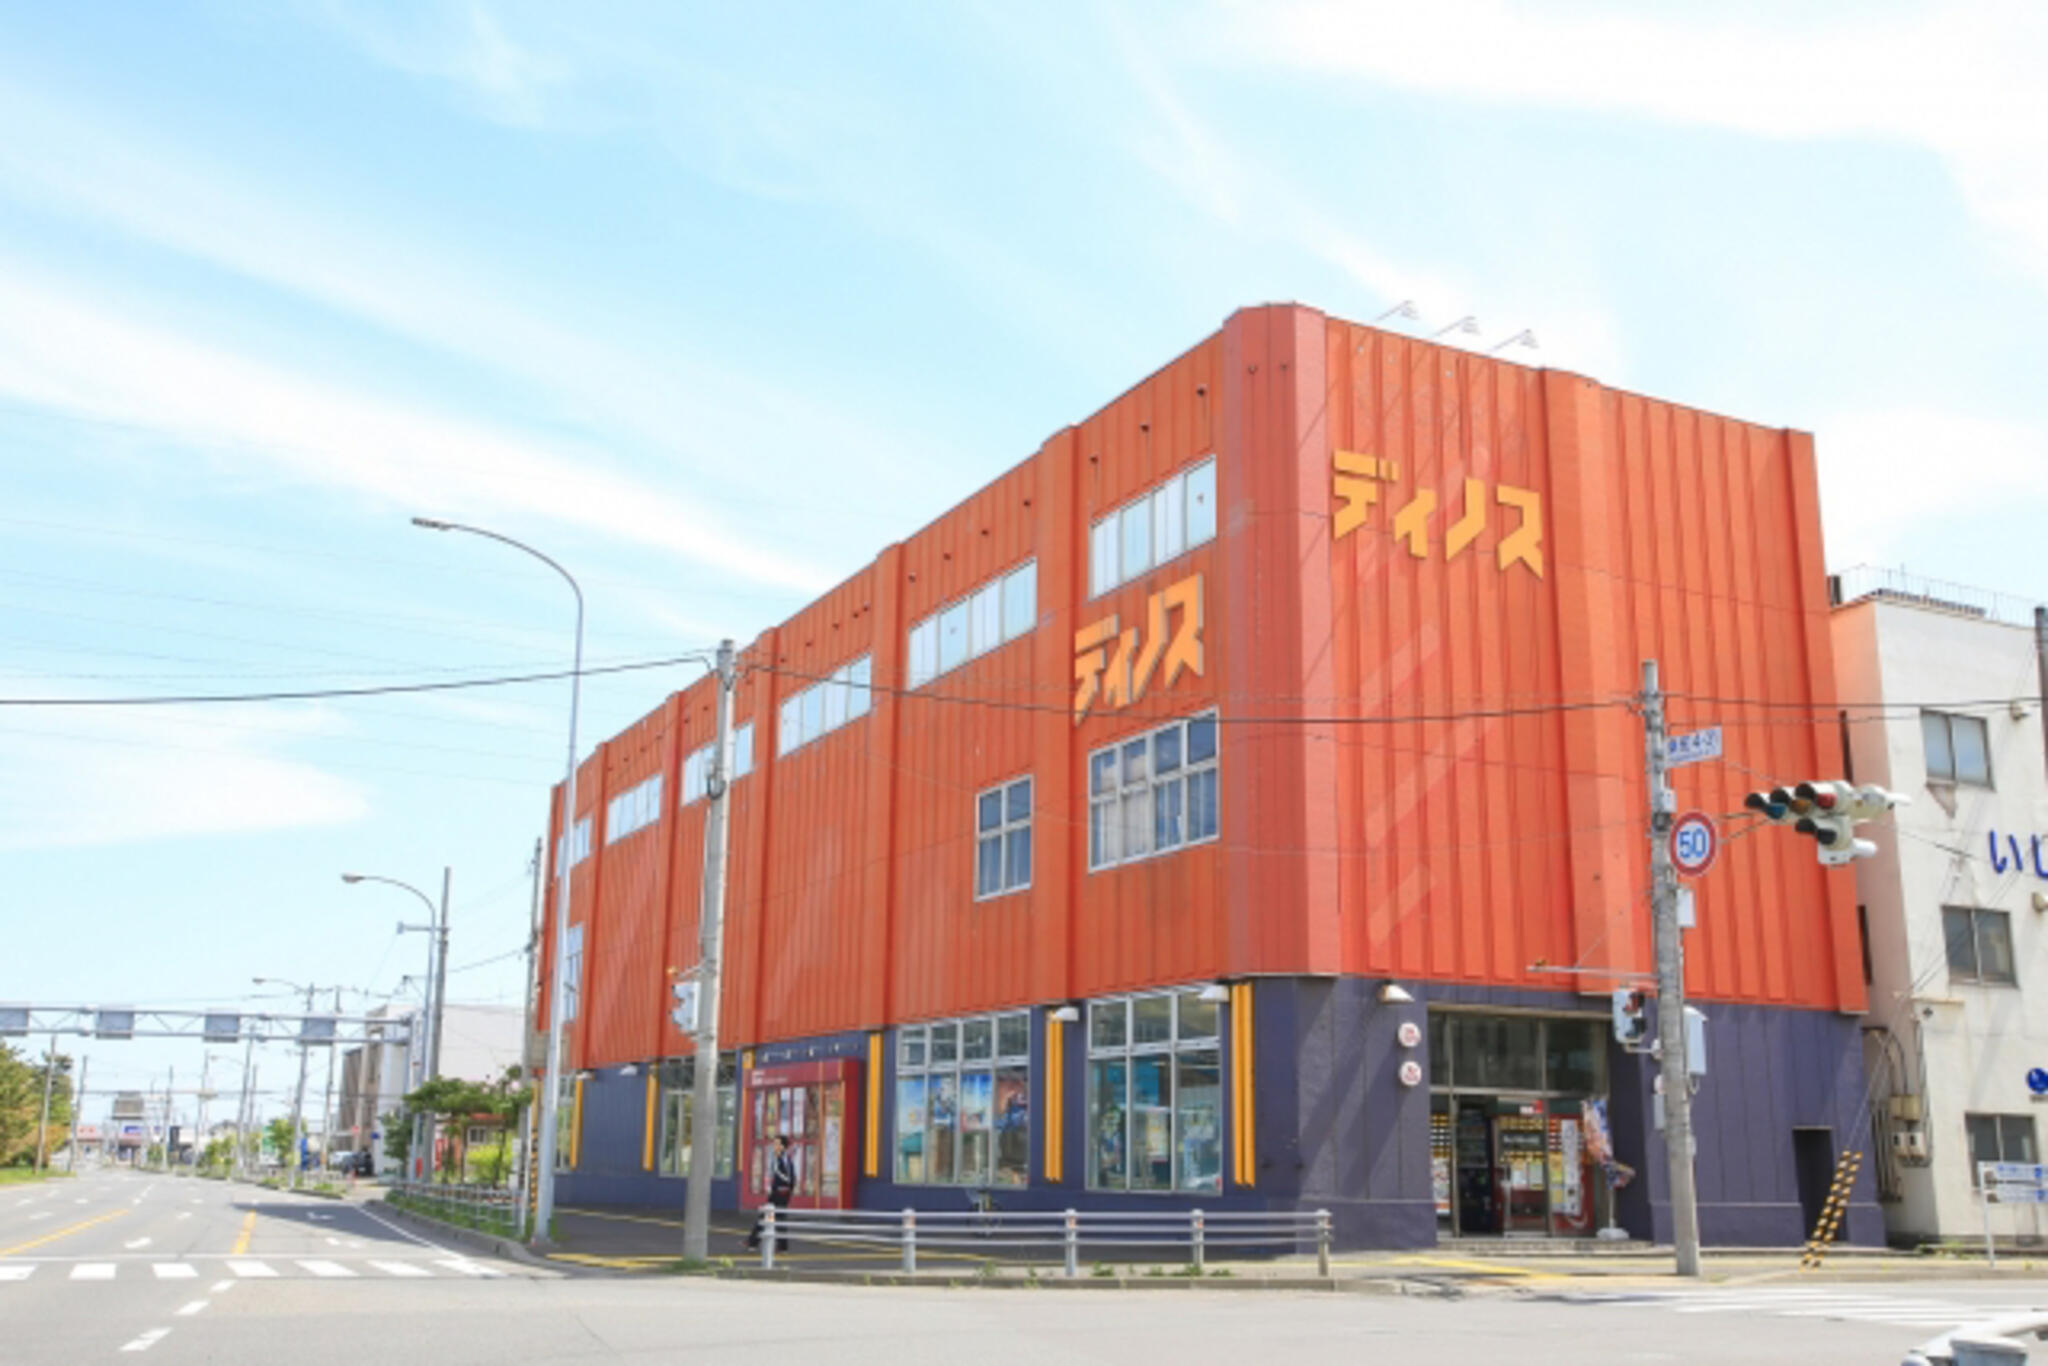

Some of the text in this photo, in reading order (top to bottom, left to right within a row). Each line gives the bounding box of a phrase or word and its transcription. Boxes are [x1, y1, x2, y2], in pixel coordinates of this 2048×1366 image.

[1333, 449, 1544, 581] ディノス
[1074, 572, 1204, 728] ディノス
[1679, 828, 1706, 858] 50
